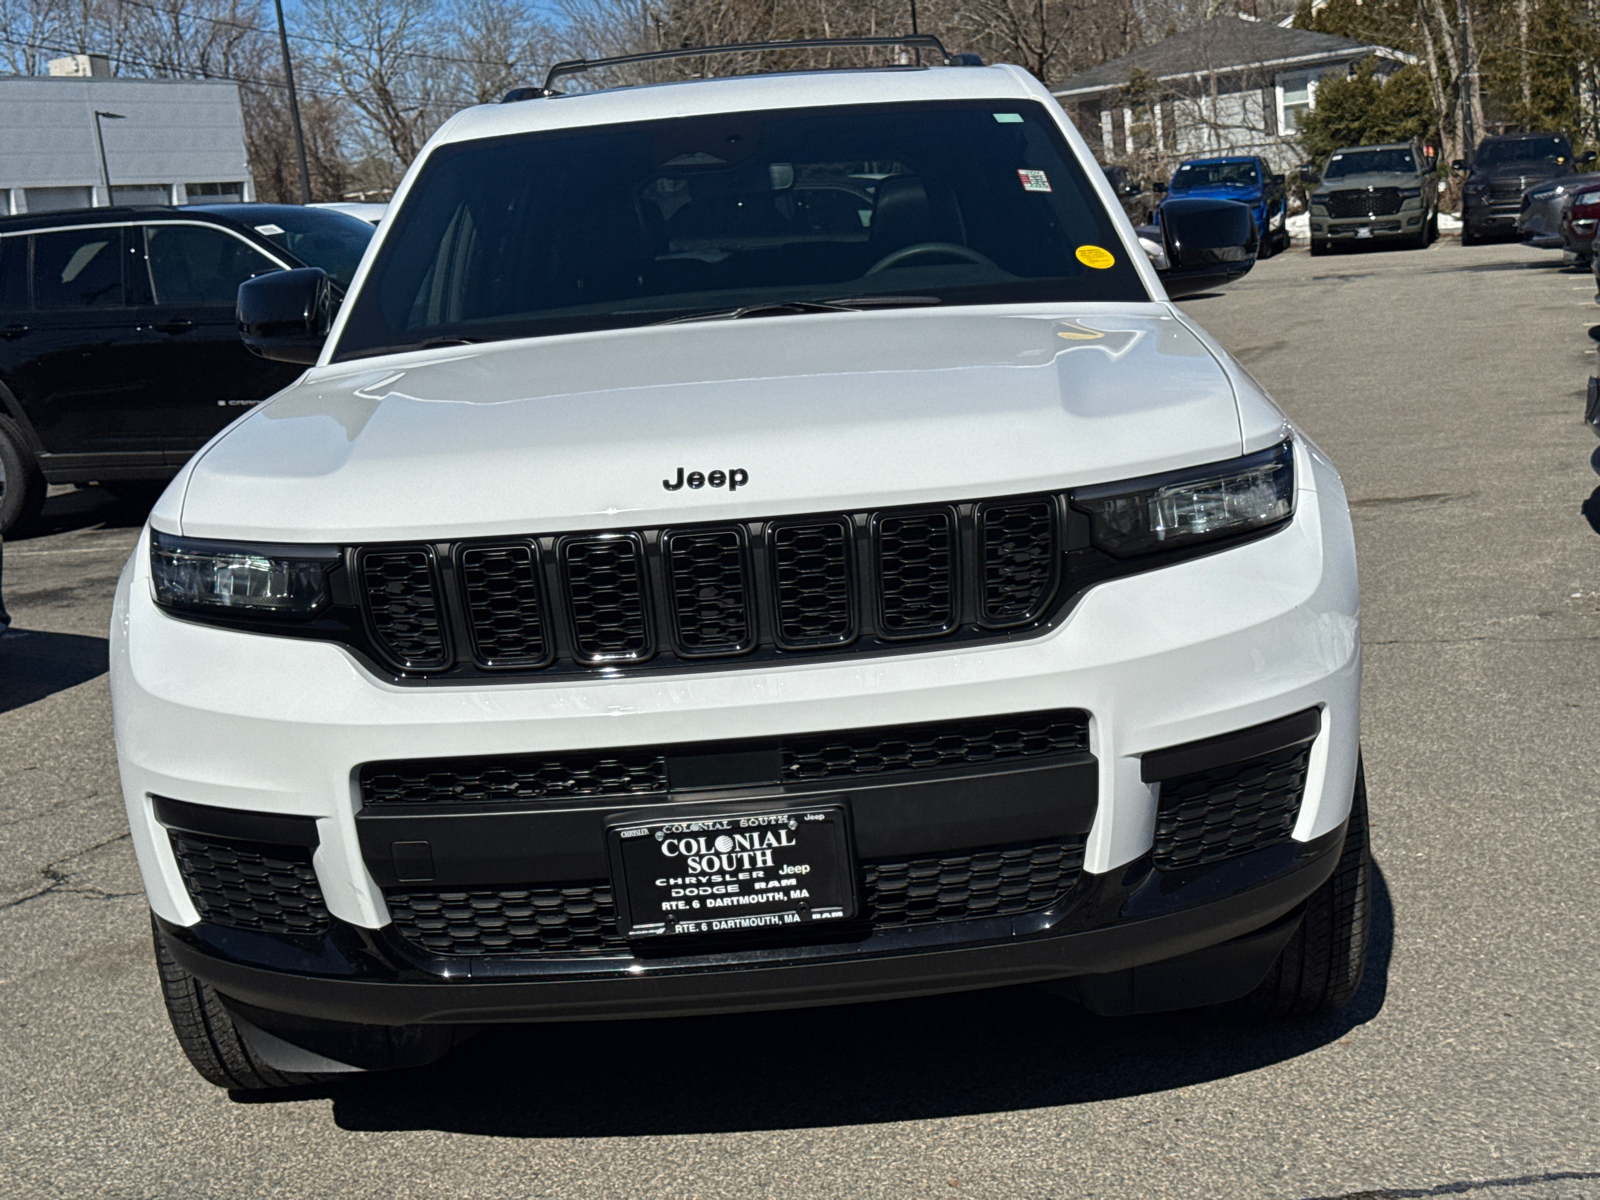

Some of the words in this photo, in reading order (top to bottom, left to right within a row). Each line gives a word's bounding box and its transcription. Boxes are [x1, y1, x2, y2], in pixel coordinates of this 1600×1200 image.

[662, 467, 749, 492] Jeep
[662, 820, 732, 834] COLONIAL
[739, 815, 789, 828] SOUTH
[804, 813, 825, 821] Jeep
[661, 829, 796, 857] COLONIAL
[687, 849, 775, 874] SOUTH
[655, 871, 765, 887] CHRYSLER
[779, 864, 811, 875] Jeep
[671, 884, 740, 897] DODGE
[754, 878, 797, 890] RAM
[661, 901, 690, 911] RTE.
[692, 900, 701, 909] 6
[706, 891, 788, 908] DARTMOUTH,
[790, 889, 810, 899] MA
[675, 923, 699, 934] RTE.
[701, 923, 708, 932] 6
[712, 916, 782, 931] DARTMOUTH,
[784, 913, 801, 924] MA
[812, 911, 844, 920] RAM
